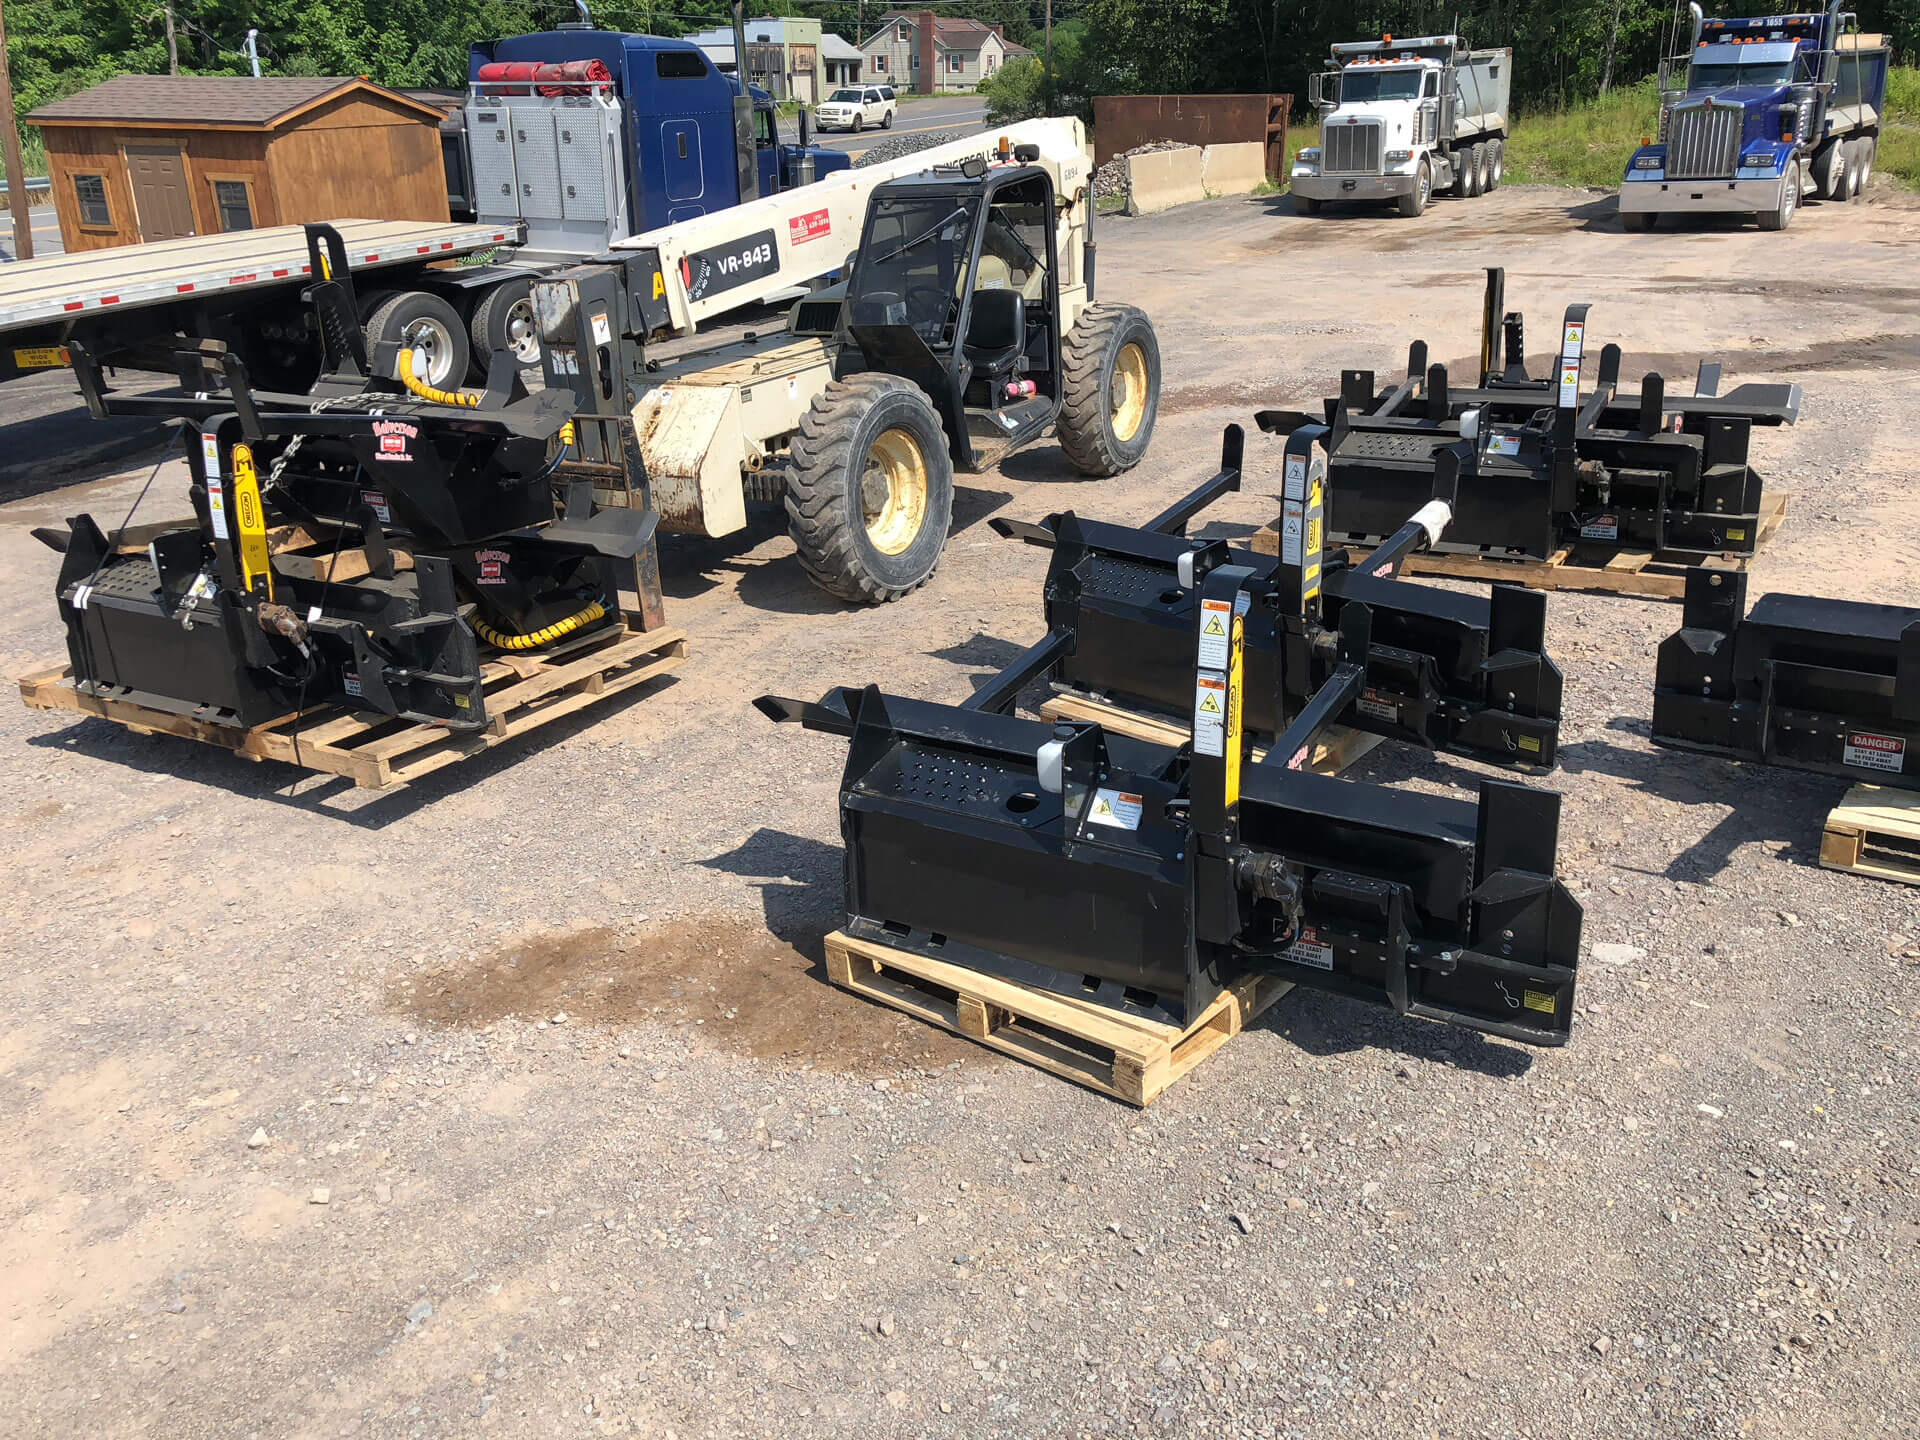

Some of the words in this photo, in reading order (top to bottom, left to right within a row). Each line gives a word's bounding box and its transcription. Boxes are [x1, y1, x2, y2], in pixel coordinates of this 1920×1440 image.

[717, 243, 772, 275] VR-843
[652, 271, 666, 301] A
[242, 495, 252, 525] OREGON
[1854, 736, 1897, 750] DANGER
